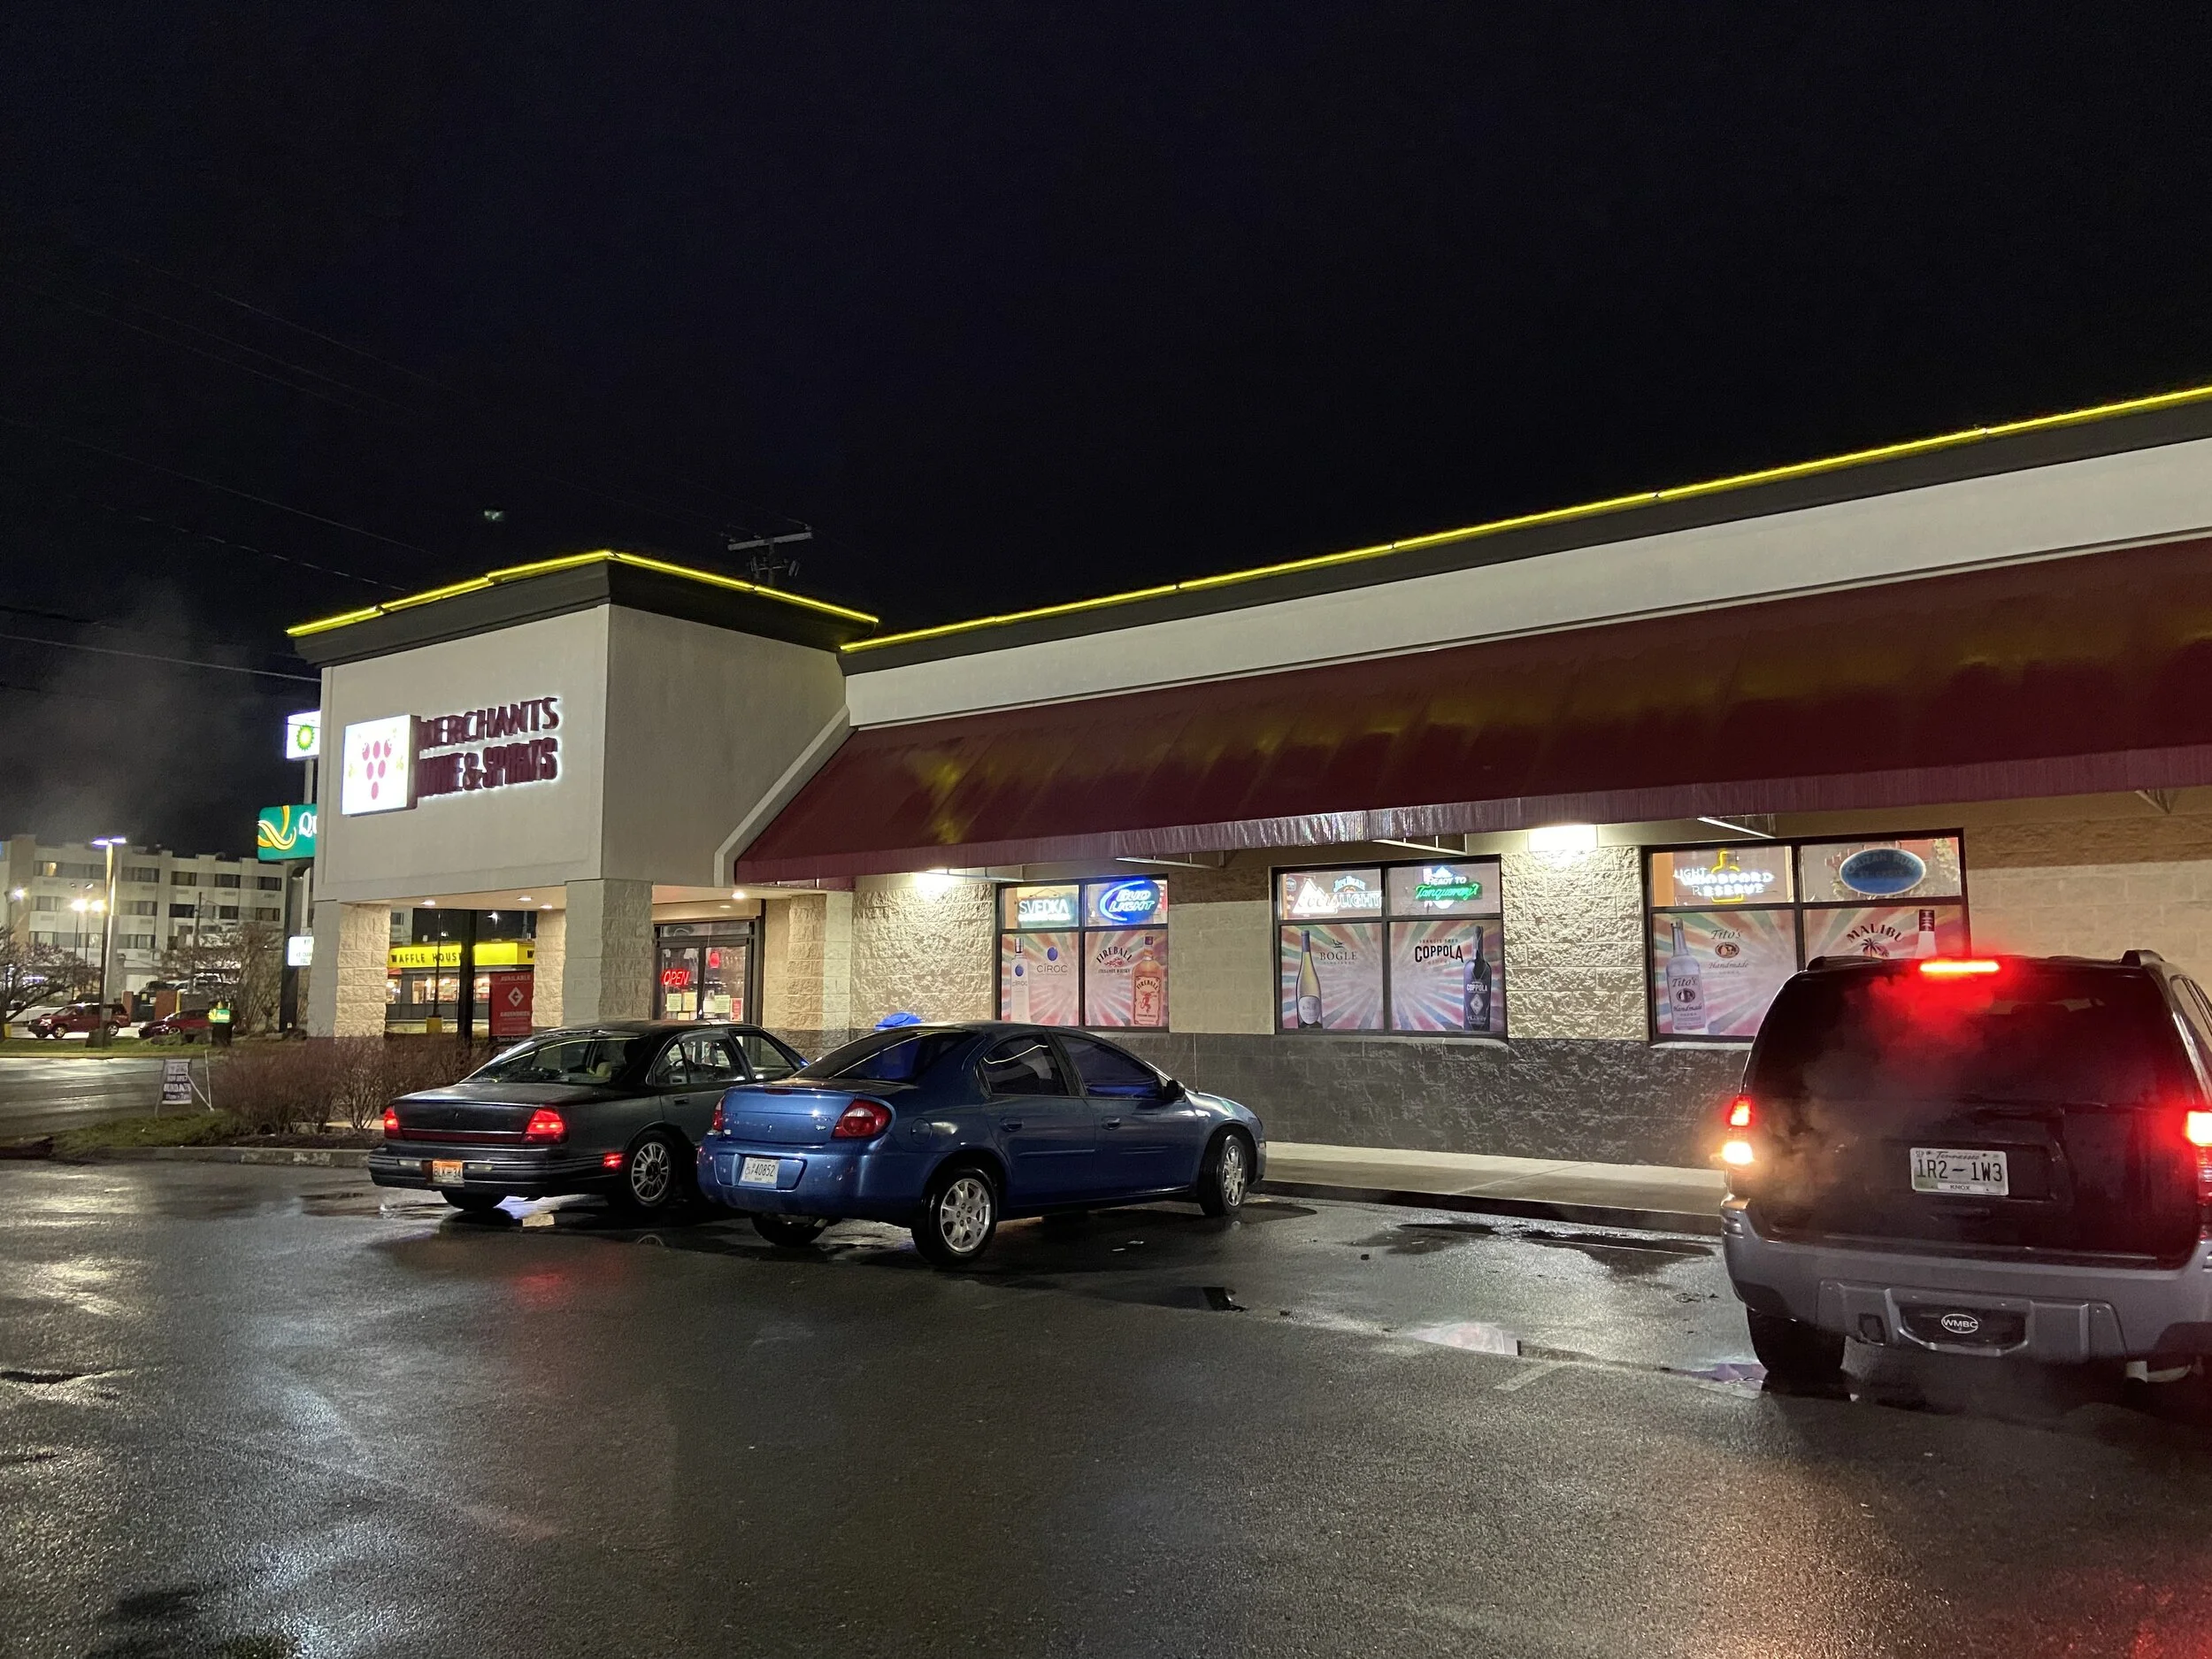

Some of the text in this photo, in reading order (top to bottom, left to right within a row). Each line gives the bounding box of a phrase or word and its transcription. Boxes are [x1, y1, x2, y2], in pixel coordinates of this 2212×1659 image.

[1116, 889, 1151, 902] BUD
[1018, 898, 1070, 914] SVEDKA
[1710, 928, 1741, 940] Tito's
[1847, 923, 1903, 943] MALIBU
[391, 953, 425, 963] WAFFLE
[1096, 946, 1133, 964] FIREBALL
[1319, 951, 1357, 961] BOGLE
[1415, 945, 1464, 963] COPPOLA
[664, 971, 689, 985] OPEN
[1671, 976, 1698, 987] Tito's
[1136, 979, 1159, 990] FIREBALL
[1466, 983, 1488, 992] COPPOLA
[1943, 1319, 1978, 1328] WMBC
